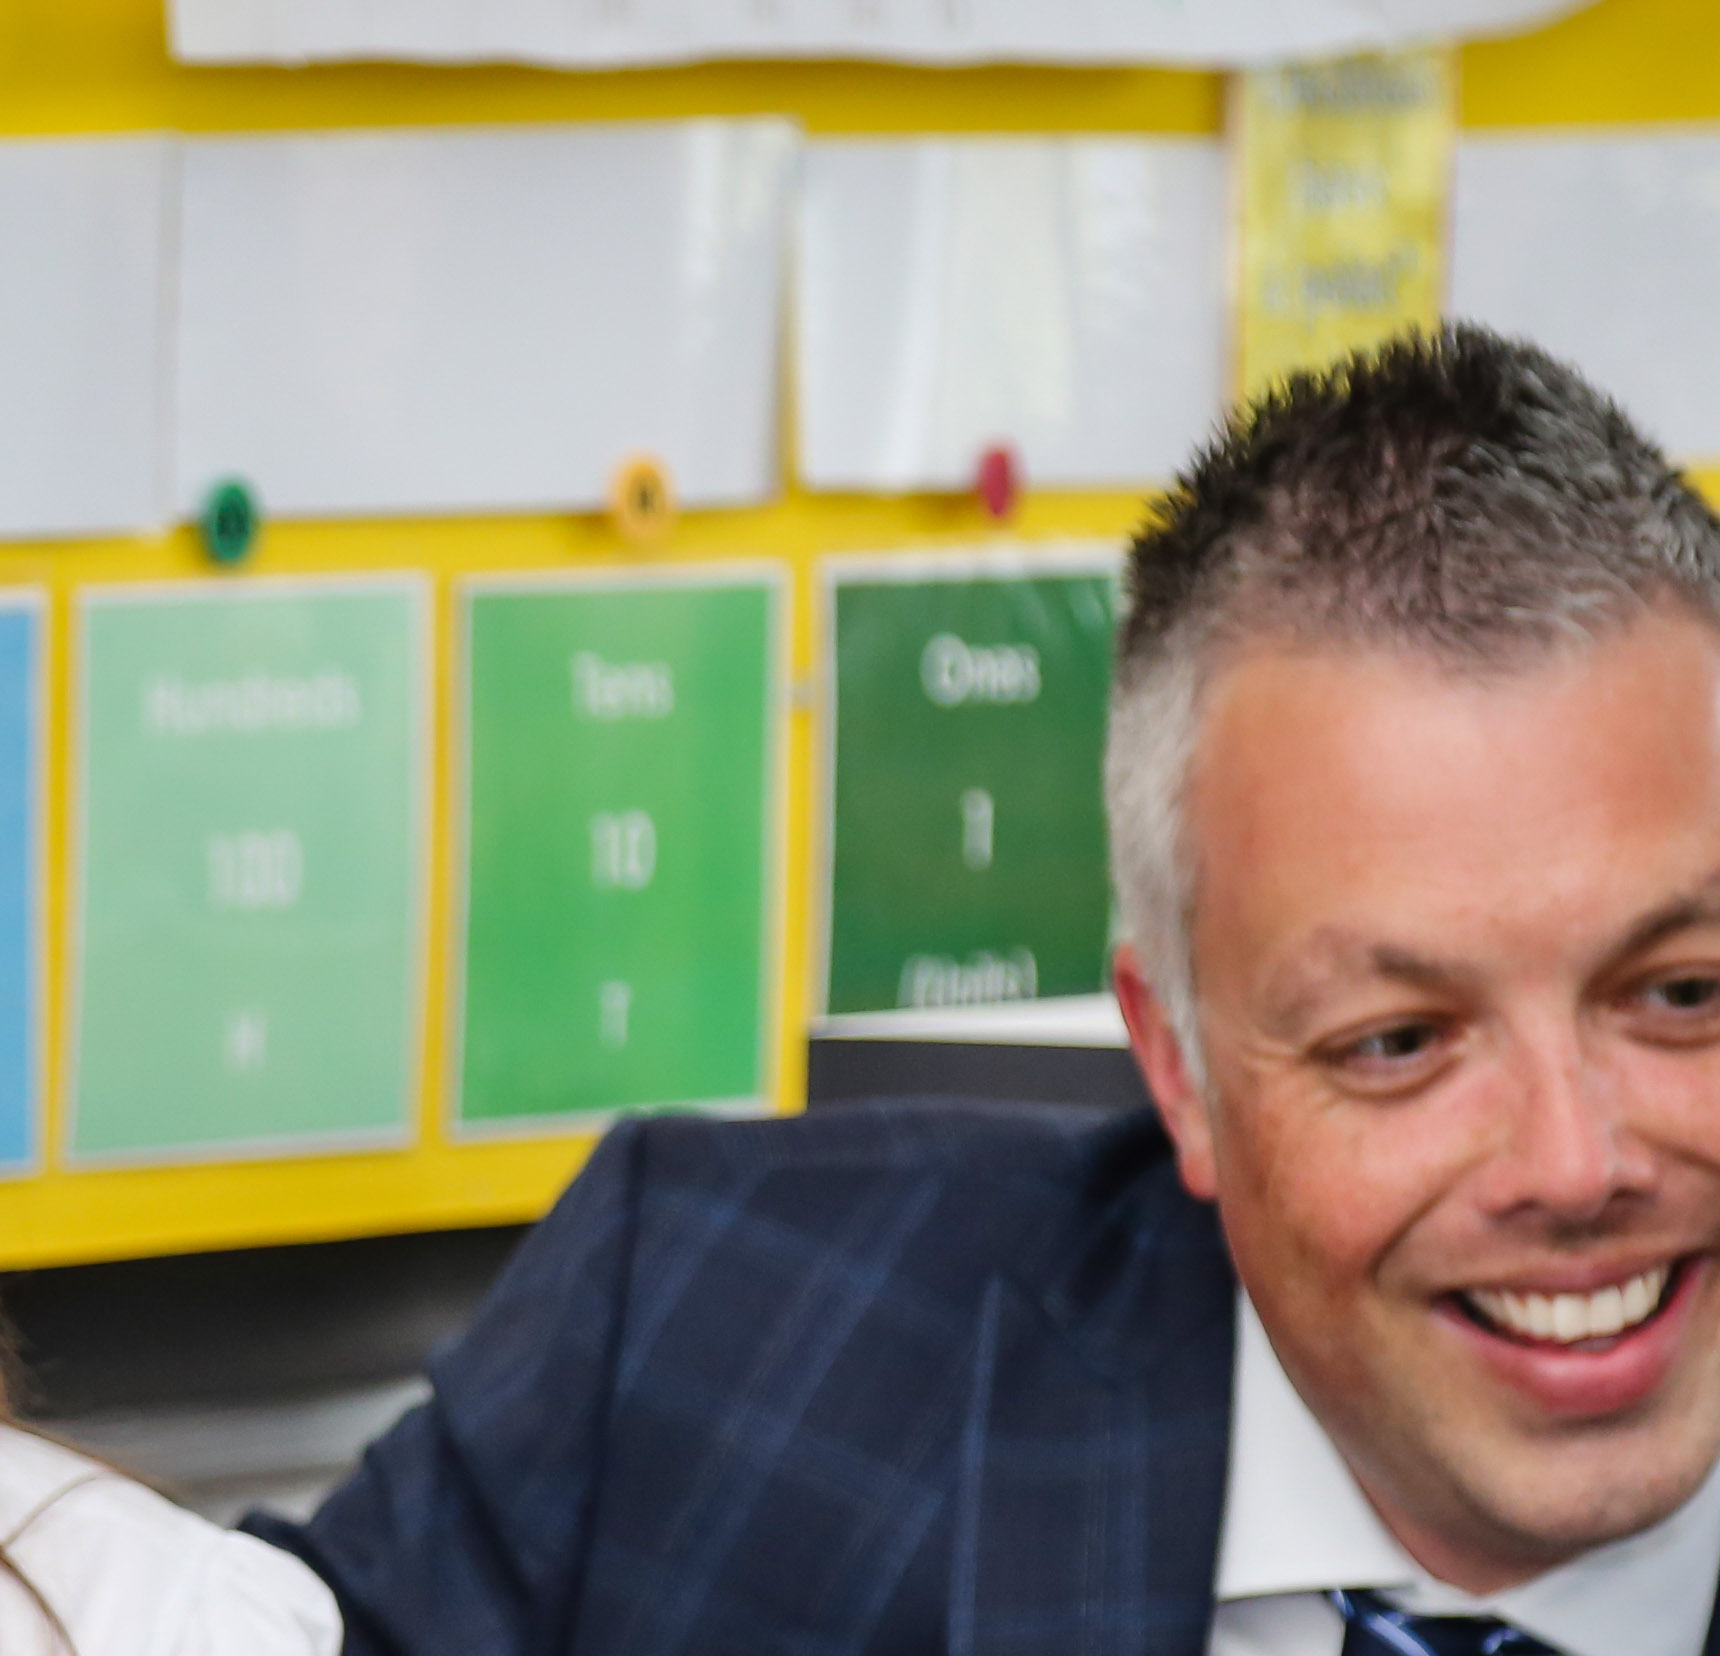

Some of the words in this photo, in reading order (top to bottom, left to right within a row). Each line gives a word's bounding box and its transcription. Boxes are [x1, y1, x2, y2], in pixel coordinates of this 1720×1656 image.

[571, 651, 674, 720] Tens
[921, 632, 1041, 706] Ones
[590, 808, 657, 891] 10
